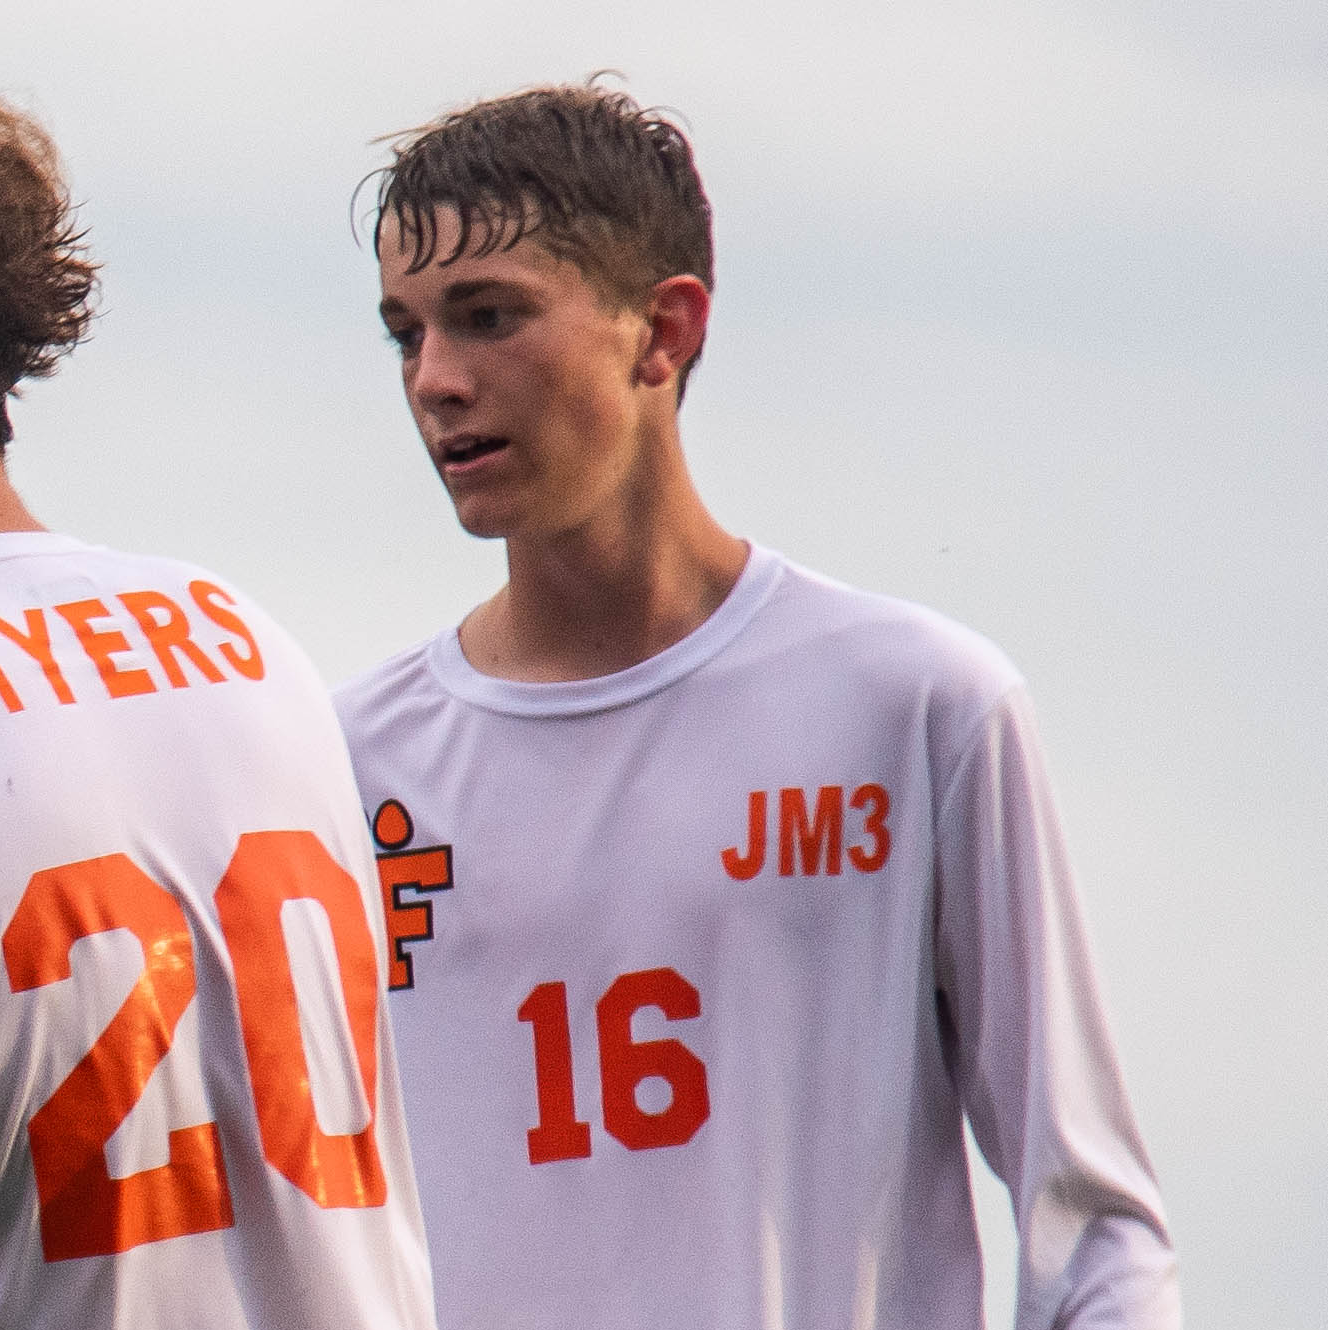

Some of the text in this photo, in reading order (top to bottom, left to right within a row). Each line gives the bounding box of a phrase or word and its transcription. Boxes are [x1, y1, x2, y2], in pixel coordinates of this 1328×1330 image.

[720, 783, 891, 881] JM3
[1, 830, 387, 1263] 20
[517, 967, 711, 1165] 16
